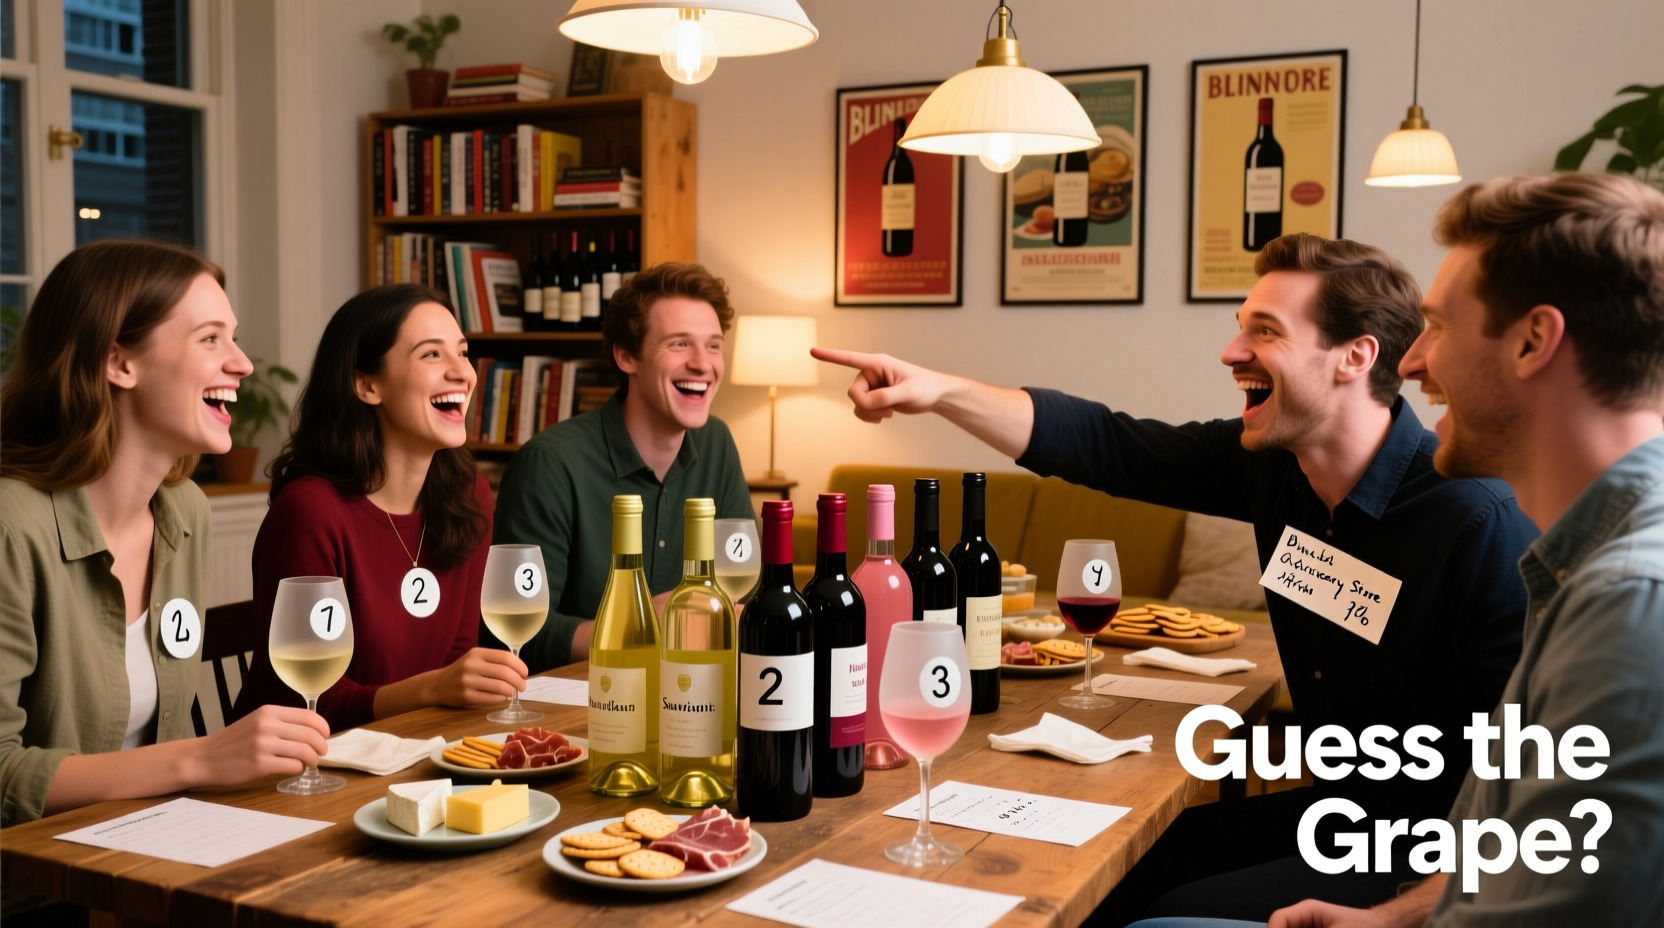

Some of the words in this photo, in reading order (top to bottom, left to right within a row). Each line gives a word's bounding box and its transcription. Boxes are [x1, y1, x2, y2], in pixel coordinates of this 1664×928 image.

[1208, 67, 1331, 99] BLINNORE
[413, 577, 428, 604] 2
[523, 568, 534, 591] 3
[320, 605, 334, 633] 7
[758, 666, 784, 706] 2
[931, 665, 951, 699] 3
